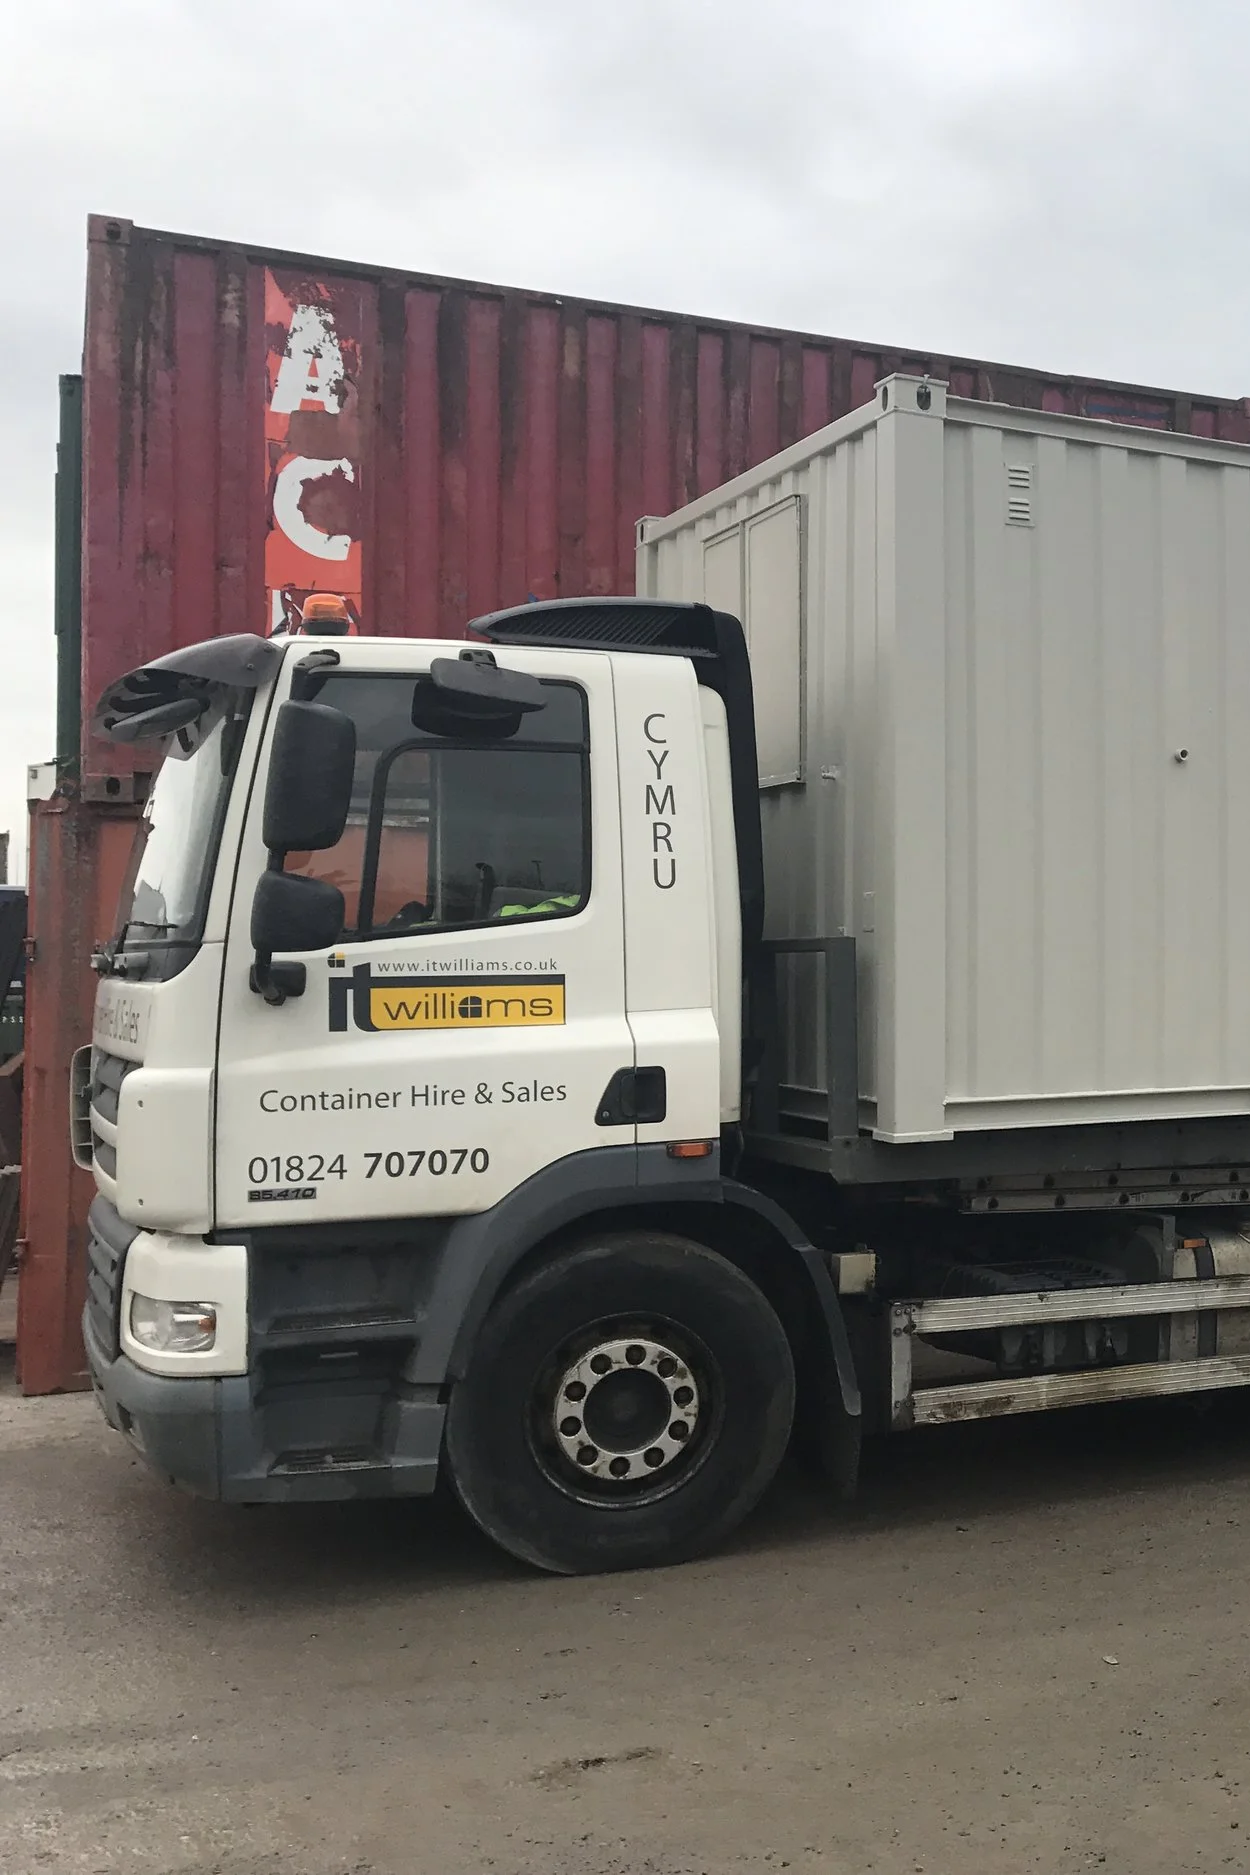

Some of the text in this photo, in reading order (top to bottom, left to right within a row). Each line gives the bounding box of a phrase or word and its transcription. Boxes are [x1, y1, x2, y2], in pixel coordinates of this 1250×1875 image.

[643, 713, 676, 889] CYMRU
[378, 958, 558, 973] www.itwilliams.co.uk
[383, 992, 553, 1021] williams
[259, 1079, 567, 1113] Container Hire & Sales
[248, 1148, 490, 1184] 01824 707070
